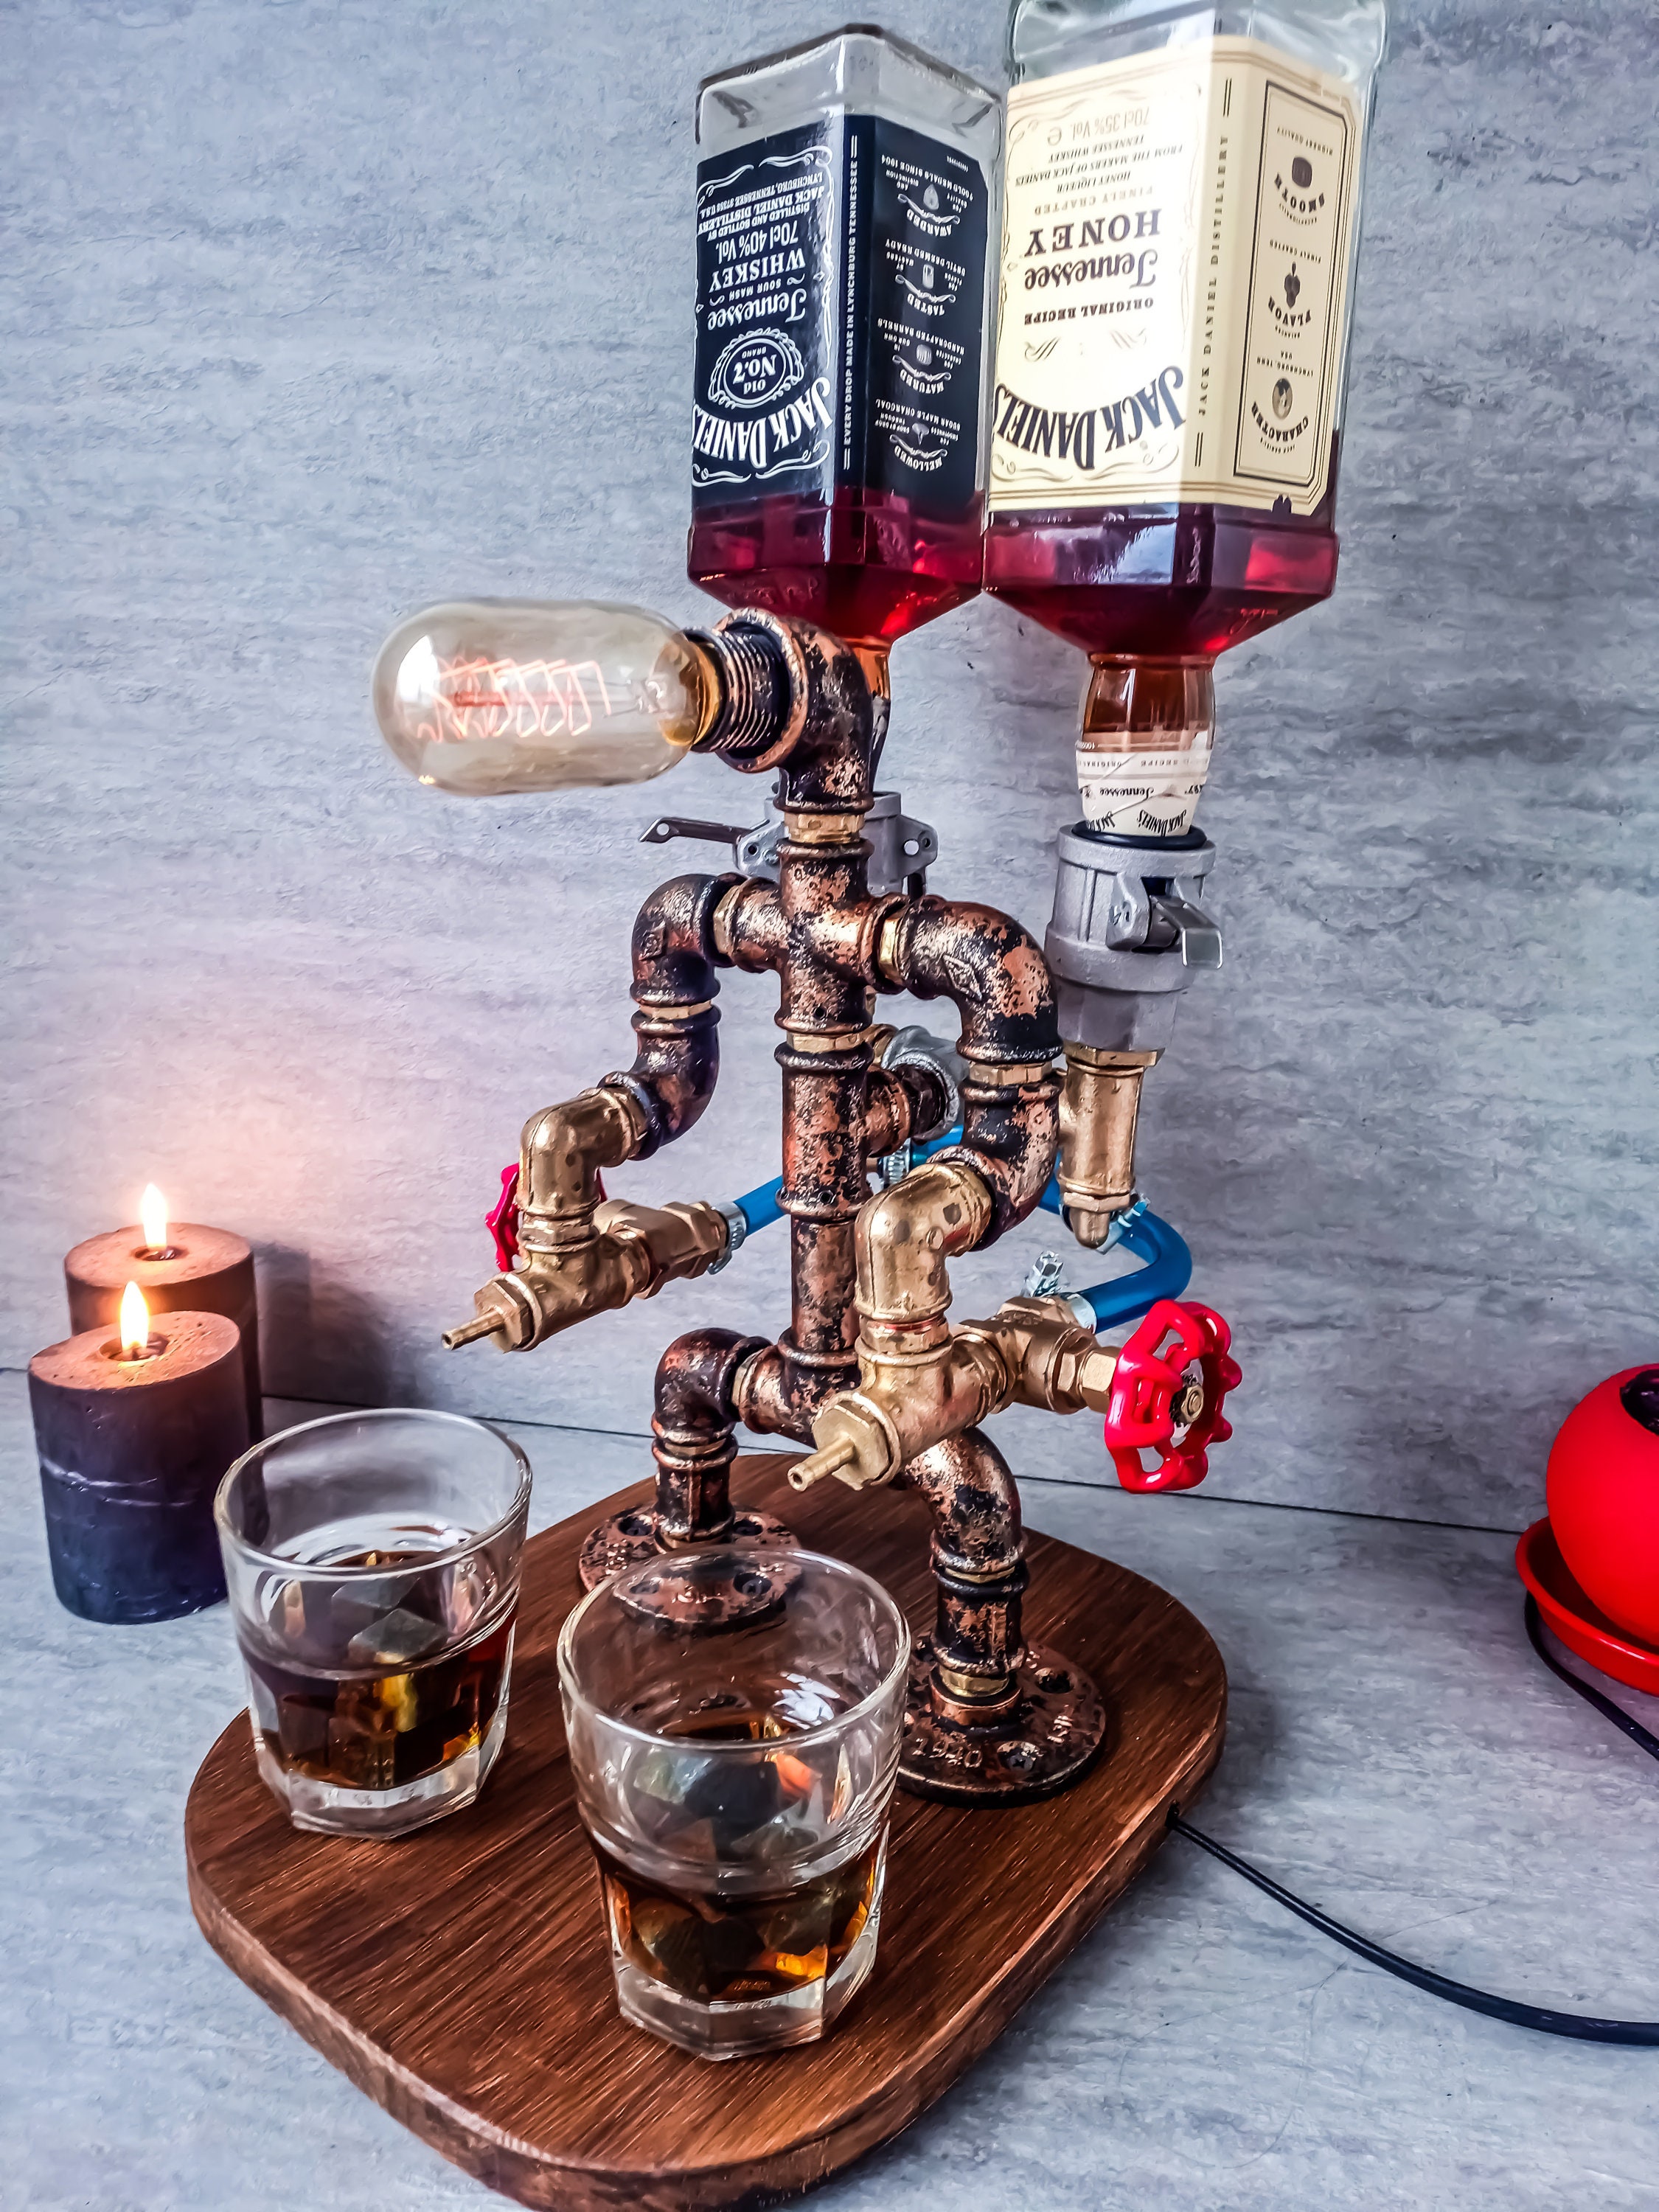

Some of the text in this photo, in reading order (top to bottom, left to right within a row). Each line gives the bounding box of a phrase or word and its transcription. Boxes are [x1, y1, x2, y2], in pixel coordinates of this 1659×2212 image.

[1094, 114, 1121, 135] 35%
[1123, 106, 1150, 128] 70cl
[1070, 120, 1091, 139] Vol.
[1047, 134, 1144, 164] TENNESSEE WHISKEY
[1131, 150, 1150, 162] THE
[1154, 145, 1183, 158] FROM
[1053, 161, 1074, 177] JACK
[1075, 163, 1088, 174] OF
[1090, 155, 1129, 170] MAKERS
[776, 172, 823, 192] LYNCHBURG,
[1056, 170, 1131, 193] HONEY LIQUEUR
[734, 184, 776, 206] TENNESSEE
[1034, 195, 1096, 215] CRAFTED
[1273, 173, 1326, 215] SMOOTH
[698, 186, 824, 234] JACK DANIEL DISTILLERY
[706, 201, 810, 241] DISTILLED AND BOTTLED BY
[906, 208, 952, 237] AWARDED
[1023, 208, 1161, 258] HONEY
[715, 220, 799, 264] 70cl 40% Vol.
[885, 238, 913, 256] READY
[709, 248, 805, 293] WHISKEY
[946, 260, 966, 276] UNTIL
[1024, 248, 1158, 291] Tennessee
[1198, 136, 1229, 417] JACK DANIEL DISTILLERY
[728, 279, 781, 302] SOUR MASH
[707, 288, 807, 330] Tennessee
[843, 161, 858, 446] EVERY DROP MADE IN LYNCHBURG TENNESSEE
[907, 295, 946, 316] TASTED
[1024, 297, 1154, 325] ORIGINAL RECIPE
[1267, 296, 1312, 327] FLAVOR
[742, 347, 767, 359] BRAND
[915, 330, 964, 355] HANDCRAFTED
[1280, 350, 1293, 361] USA
[743, 379, 766, 395] Old
[900, 368, 944, 394] MATURED
[768, 377, 833, 453] JACK
[875, 398, 915, 417] CHARCOAL
[917, 409, 939, 423] MAPLE
[1099, 365, 1186, 453] JACK
[1251, 401, 1310, 443] CHARACTER
[894, 445, 943, 472] MELLOWED
[1099, 787, 1154, 799] Tennessee
[1167, 809, 1187, 833] JACK
